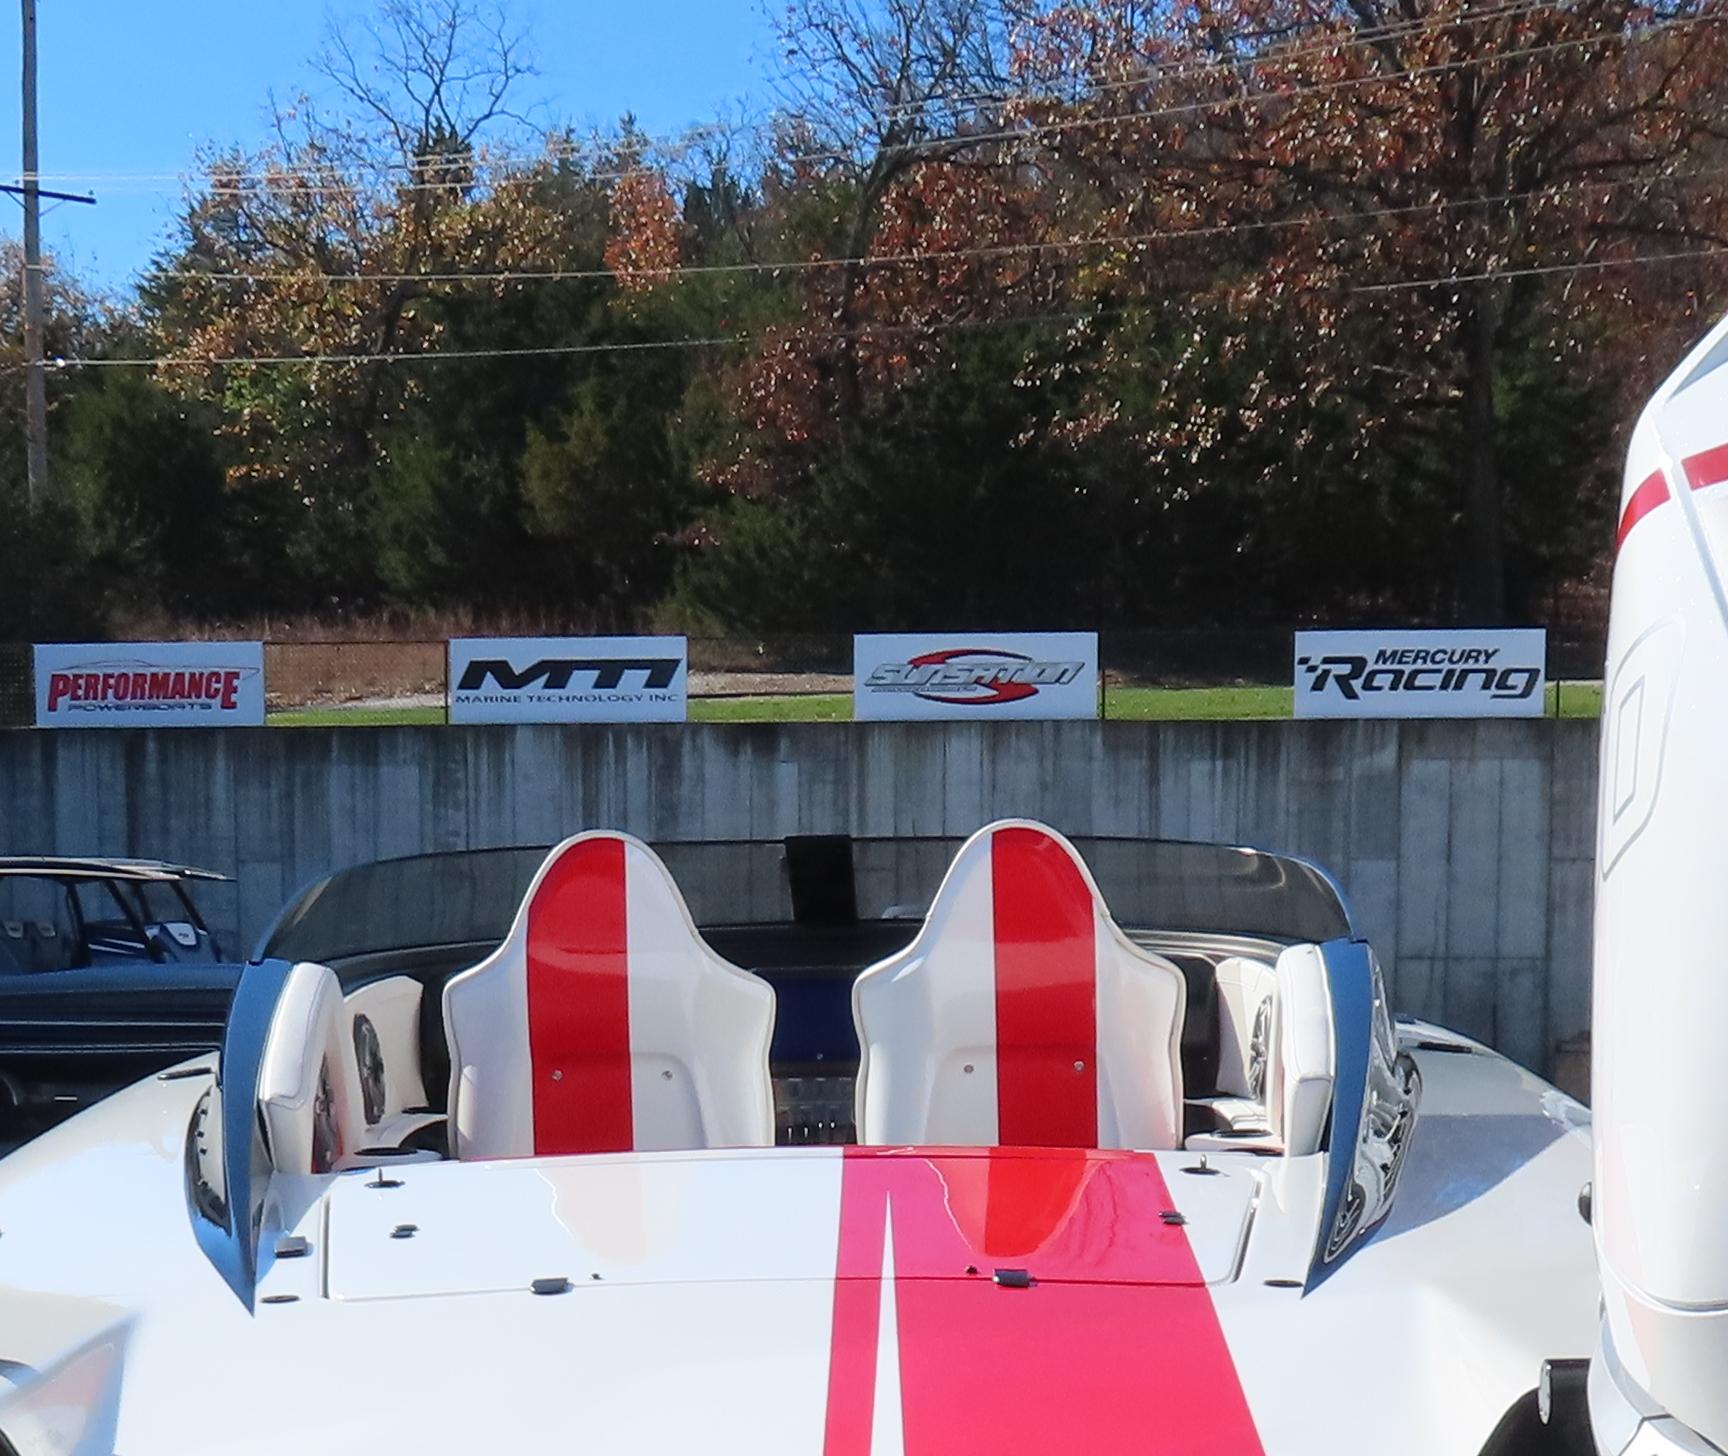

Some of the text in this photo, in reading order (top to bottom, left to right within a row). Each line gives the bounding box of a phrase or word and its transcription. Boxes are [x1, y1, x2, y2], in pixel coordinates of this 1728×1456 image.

[1374, 648, 1500, 666] MERCURY
[457, 658, 683, 690] MTI
[1297, 655, 1541, 700] Racing
[47, 671, 241, 712] PERFORMANCE
[456, 695, 521, 704] MARINE
[527, 694, 644, 703] TECHNOLOGY
[68, 702, 212, 712] POWERSPORTS
